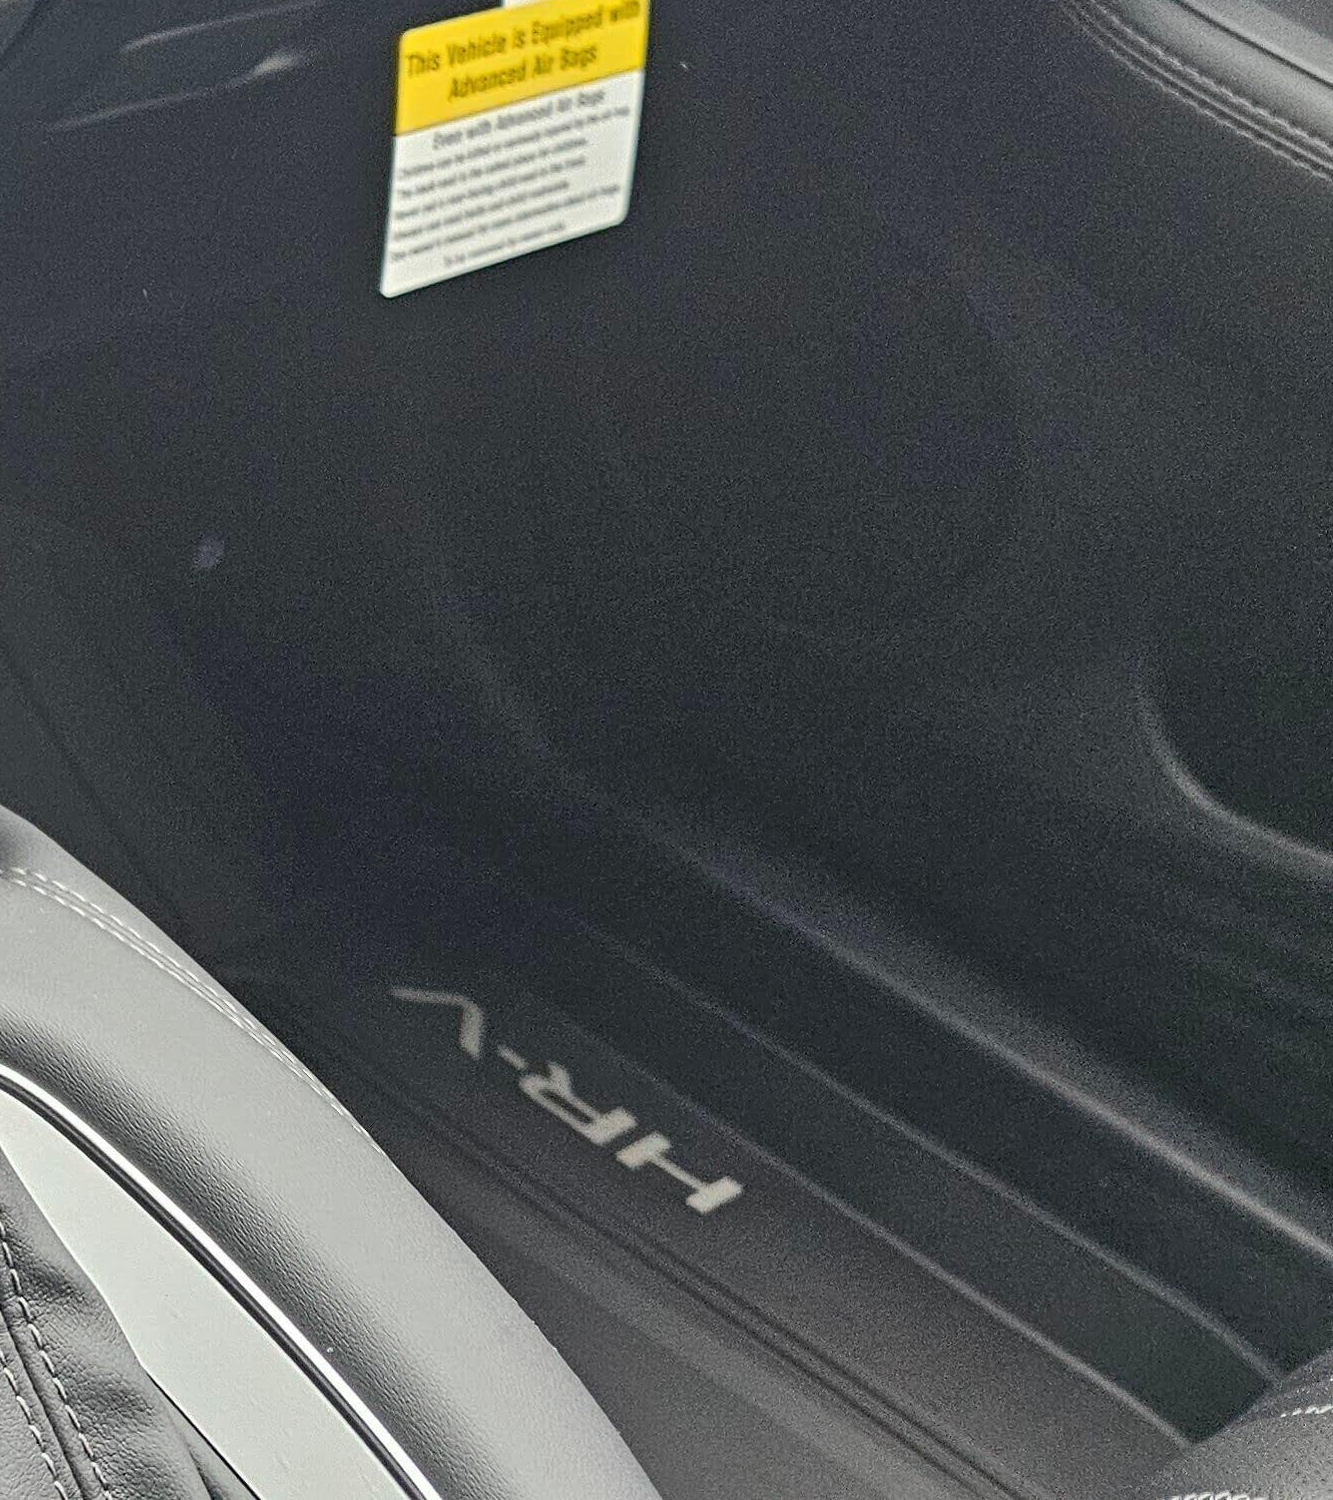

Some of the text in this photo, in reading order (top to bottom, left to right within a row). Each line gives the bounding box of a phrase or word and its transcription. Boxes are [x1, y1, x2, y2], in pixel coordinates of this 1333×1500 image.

[407, 50, 441, 77] This
[446, 33, 507, 67] Vehicle
[512, 27, 526, 49] is
[448, 60, 527, 100] Advanced
[533, 53, 554, 75] Air
[391, 986, 744, 1215] HR-V
